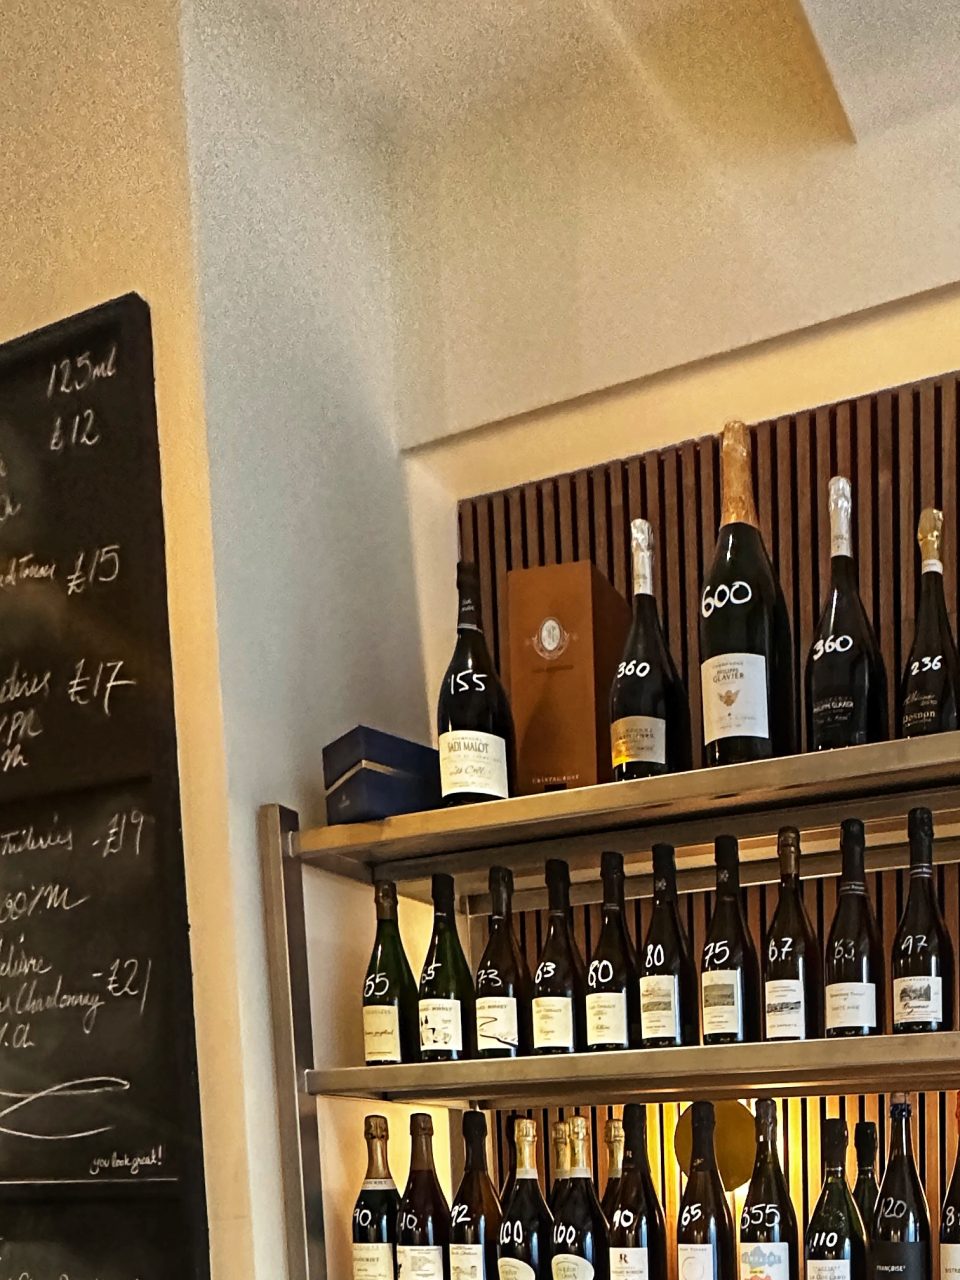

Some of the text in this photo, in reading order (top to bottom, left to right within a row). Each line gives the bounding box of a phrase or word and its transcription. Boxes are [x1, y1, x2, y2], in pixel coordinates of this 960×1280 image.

[67, 545, 120, 595] £15
[702, 581, 752, 618] 600
[813, 635, 853, 661] 360
[617, 660, 650, 678] 360
[713, 672, 744, 683] GLAVIER
[911, 655, 942, 676] 236
[68, 659, 136, 716] £17
[451, 669, 489, 695] 155
[645, 944, 665, 968] 80
[704, 940, 730, 968] 75
[106, 958, 152, 1016] £21
[89, 1158, 110, 1175] you
[112, 1151, 131, 1168] look
[681, 1203, 702, 1228] 65
